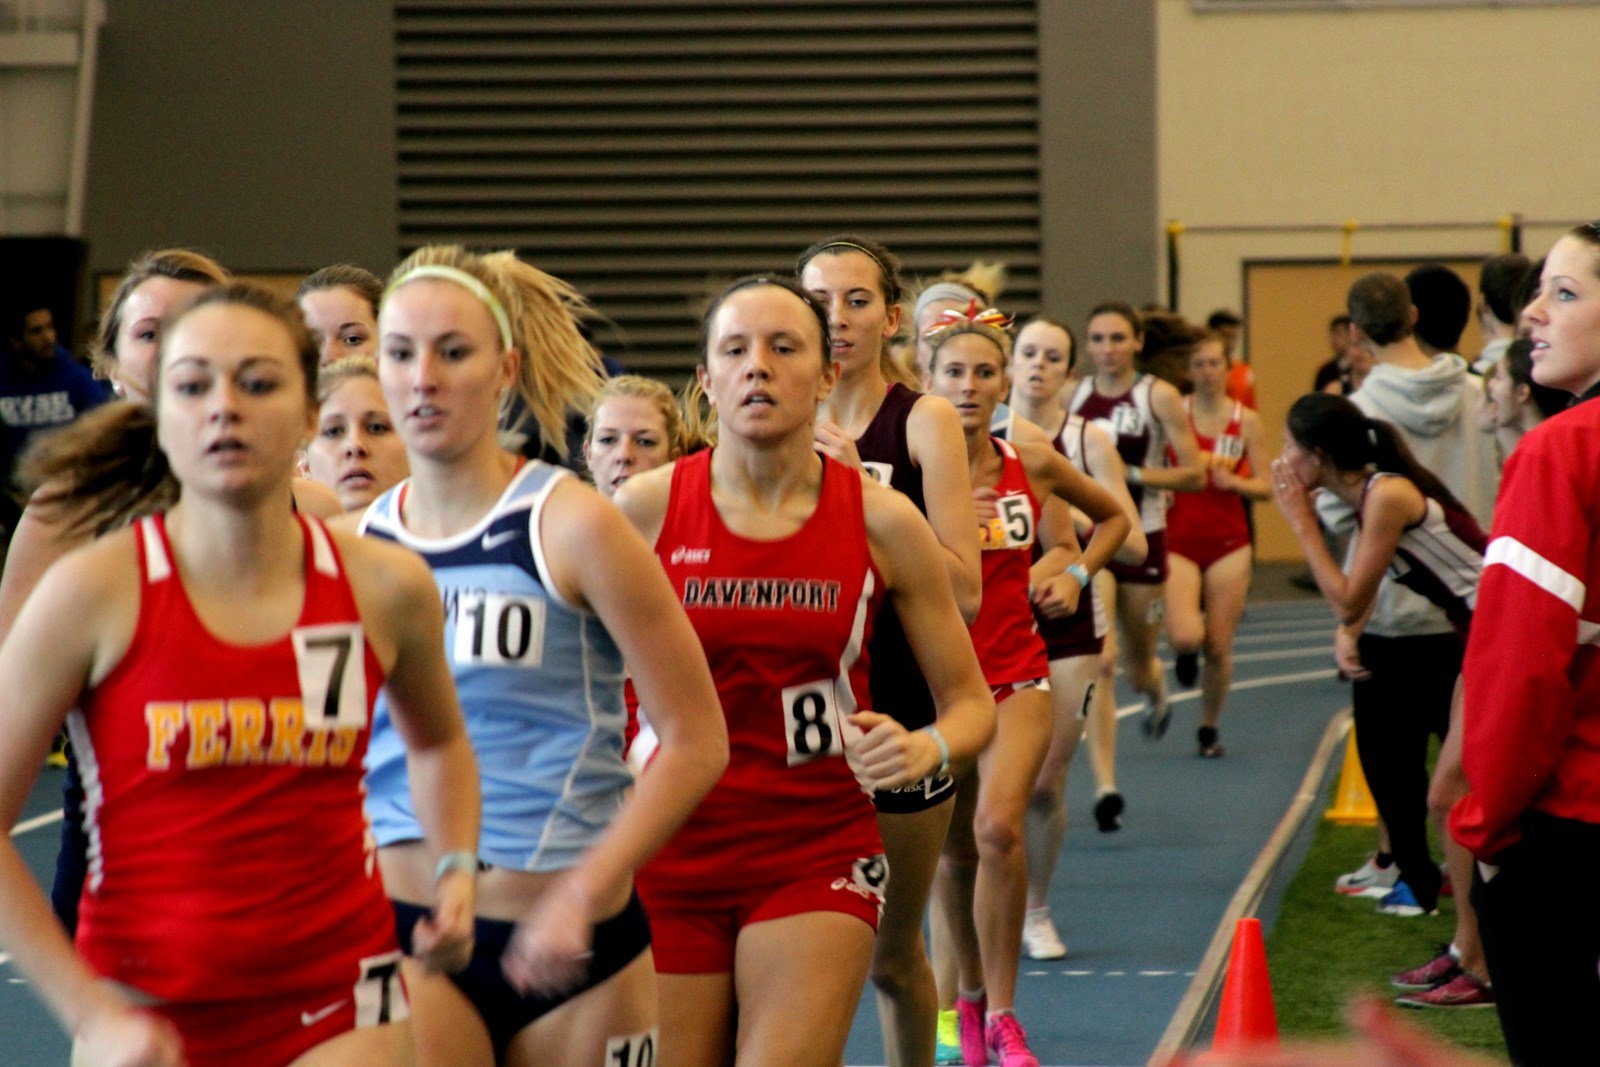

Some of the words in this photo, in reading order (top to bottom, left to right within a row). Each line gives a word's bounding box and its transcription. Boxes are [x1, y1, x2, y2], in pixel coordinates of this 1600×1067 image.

[1002, 498, 1029, 542] 5
[684, 577, 840, 613] DAVENPORT
[465, 600, 532, 660] 10
[304, 635, 353, 718] 7
[792, 691, 833, 755] 8
[366, 961, 399, 1025] 7
